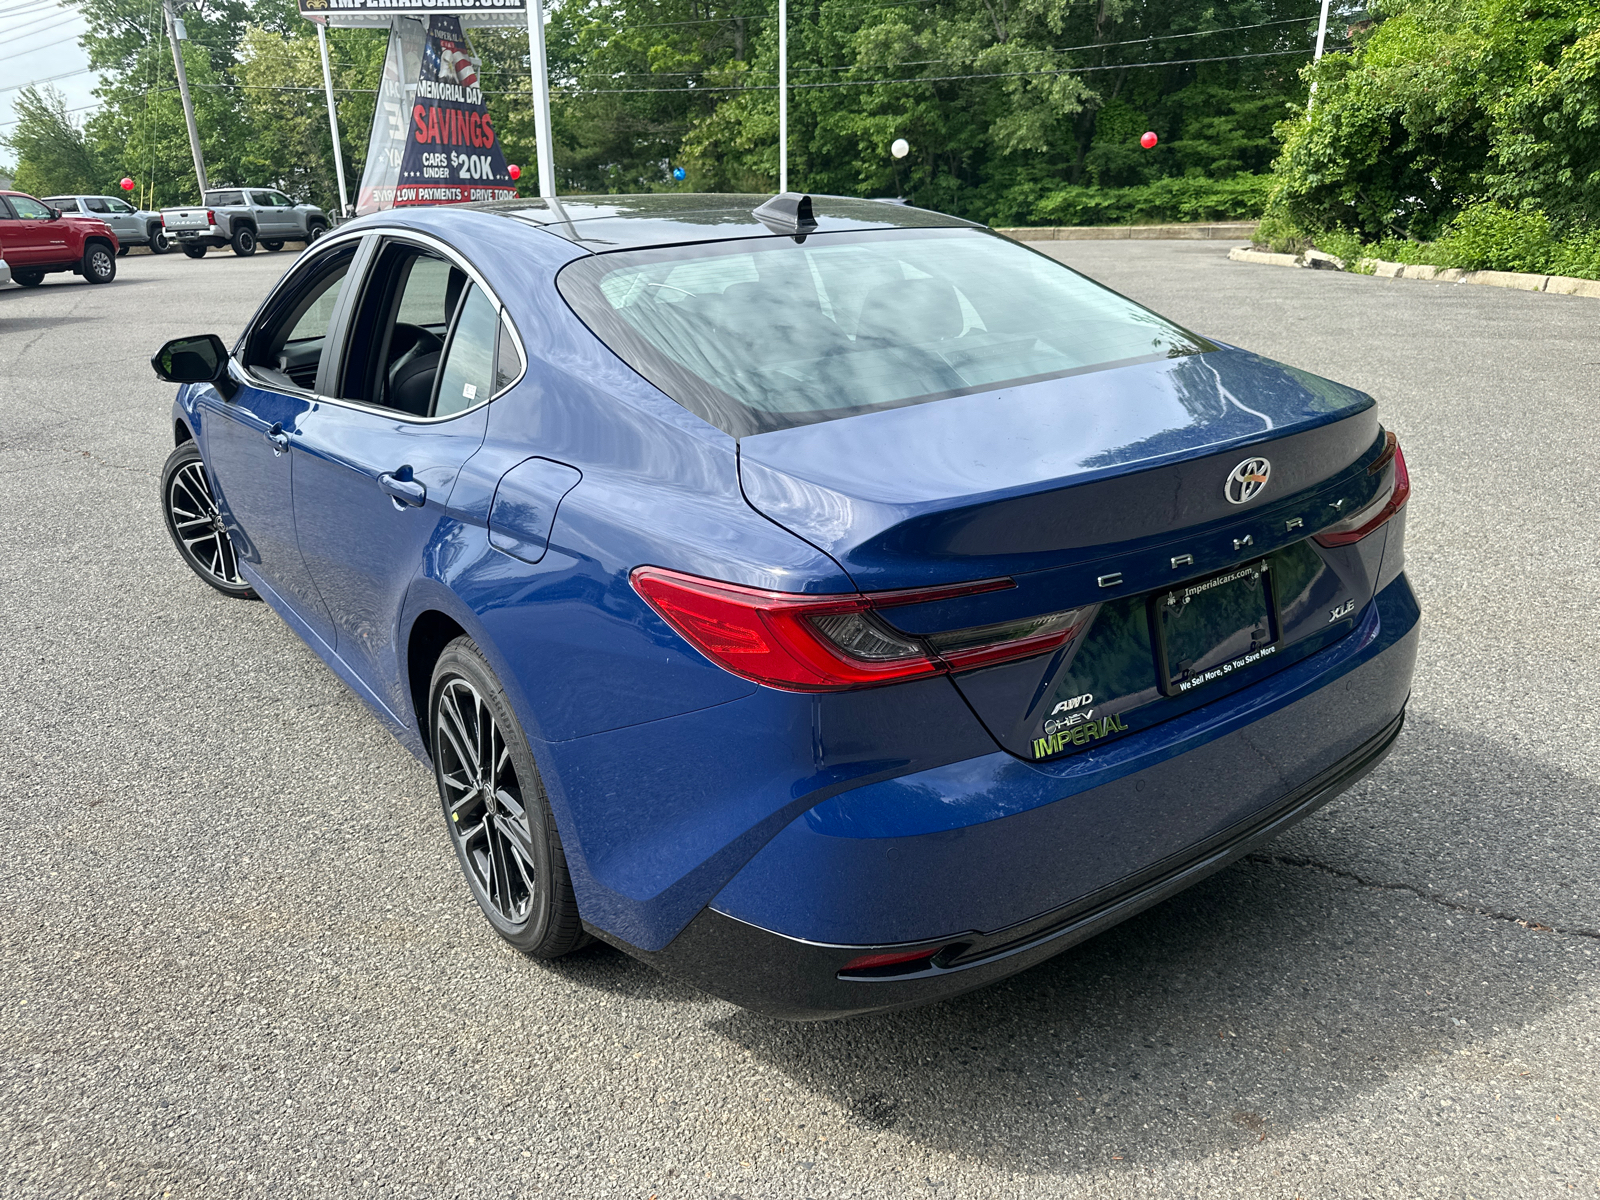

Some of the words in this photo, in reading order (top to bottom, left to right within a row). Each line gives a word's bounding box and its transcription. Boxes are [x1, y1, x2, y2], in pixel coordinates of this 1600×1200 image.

[417, 80, 465, 102] MEMORIAL
[466, 87, 482, 105] DAY
[413, 104, 495, 149] SAVINGS
[422, 152, 447, 166] CARS
[451, 150, 494, 180] $20K
[423, 167, 449, 179] UNDER
[397, 188, 416, 201] LOW
[419, 188, 461, 201] PAYMENTS
[470, 189, 493, 201] DRIVE
[1097, 498, 1345, 588] CAMRY
[1184, 567, 1253, 598] Imperialcars.com
[1328, 598, 1356, 623] XLE
[1179, 682, 1192, 692] We
[1191, 676, 1204, 687] Sell
[1205, 669, 1223, 682] More,
[1223, 664, 1232, 674] So
[1232, 659, 1245, 669] You
[1245, 652, 1260, 664] Save
[1260, 645, 1276, 657] More
[1050, 693, 1093, 716] AWD
[1031, 713, 1129, 759] IMPERIAL
